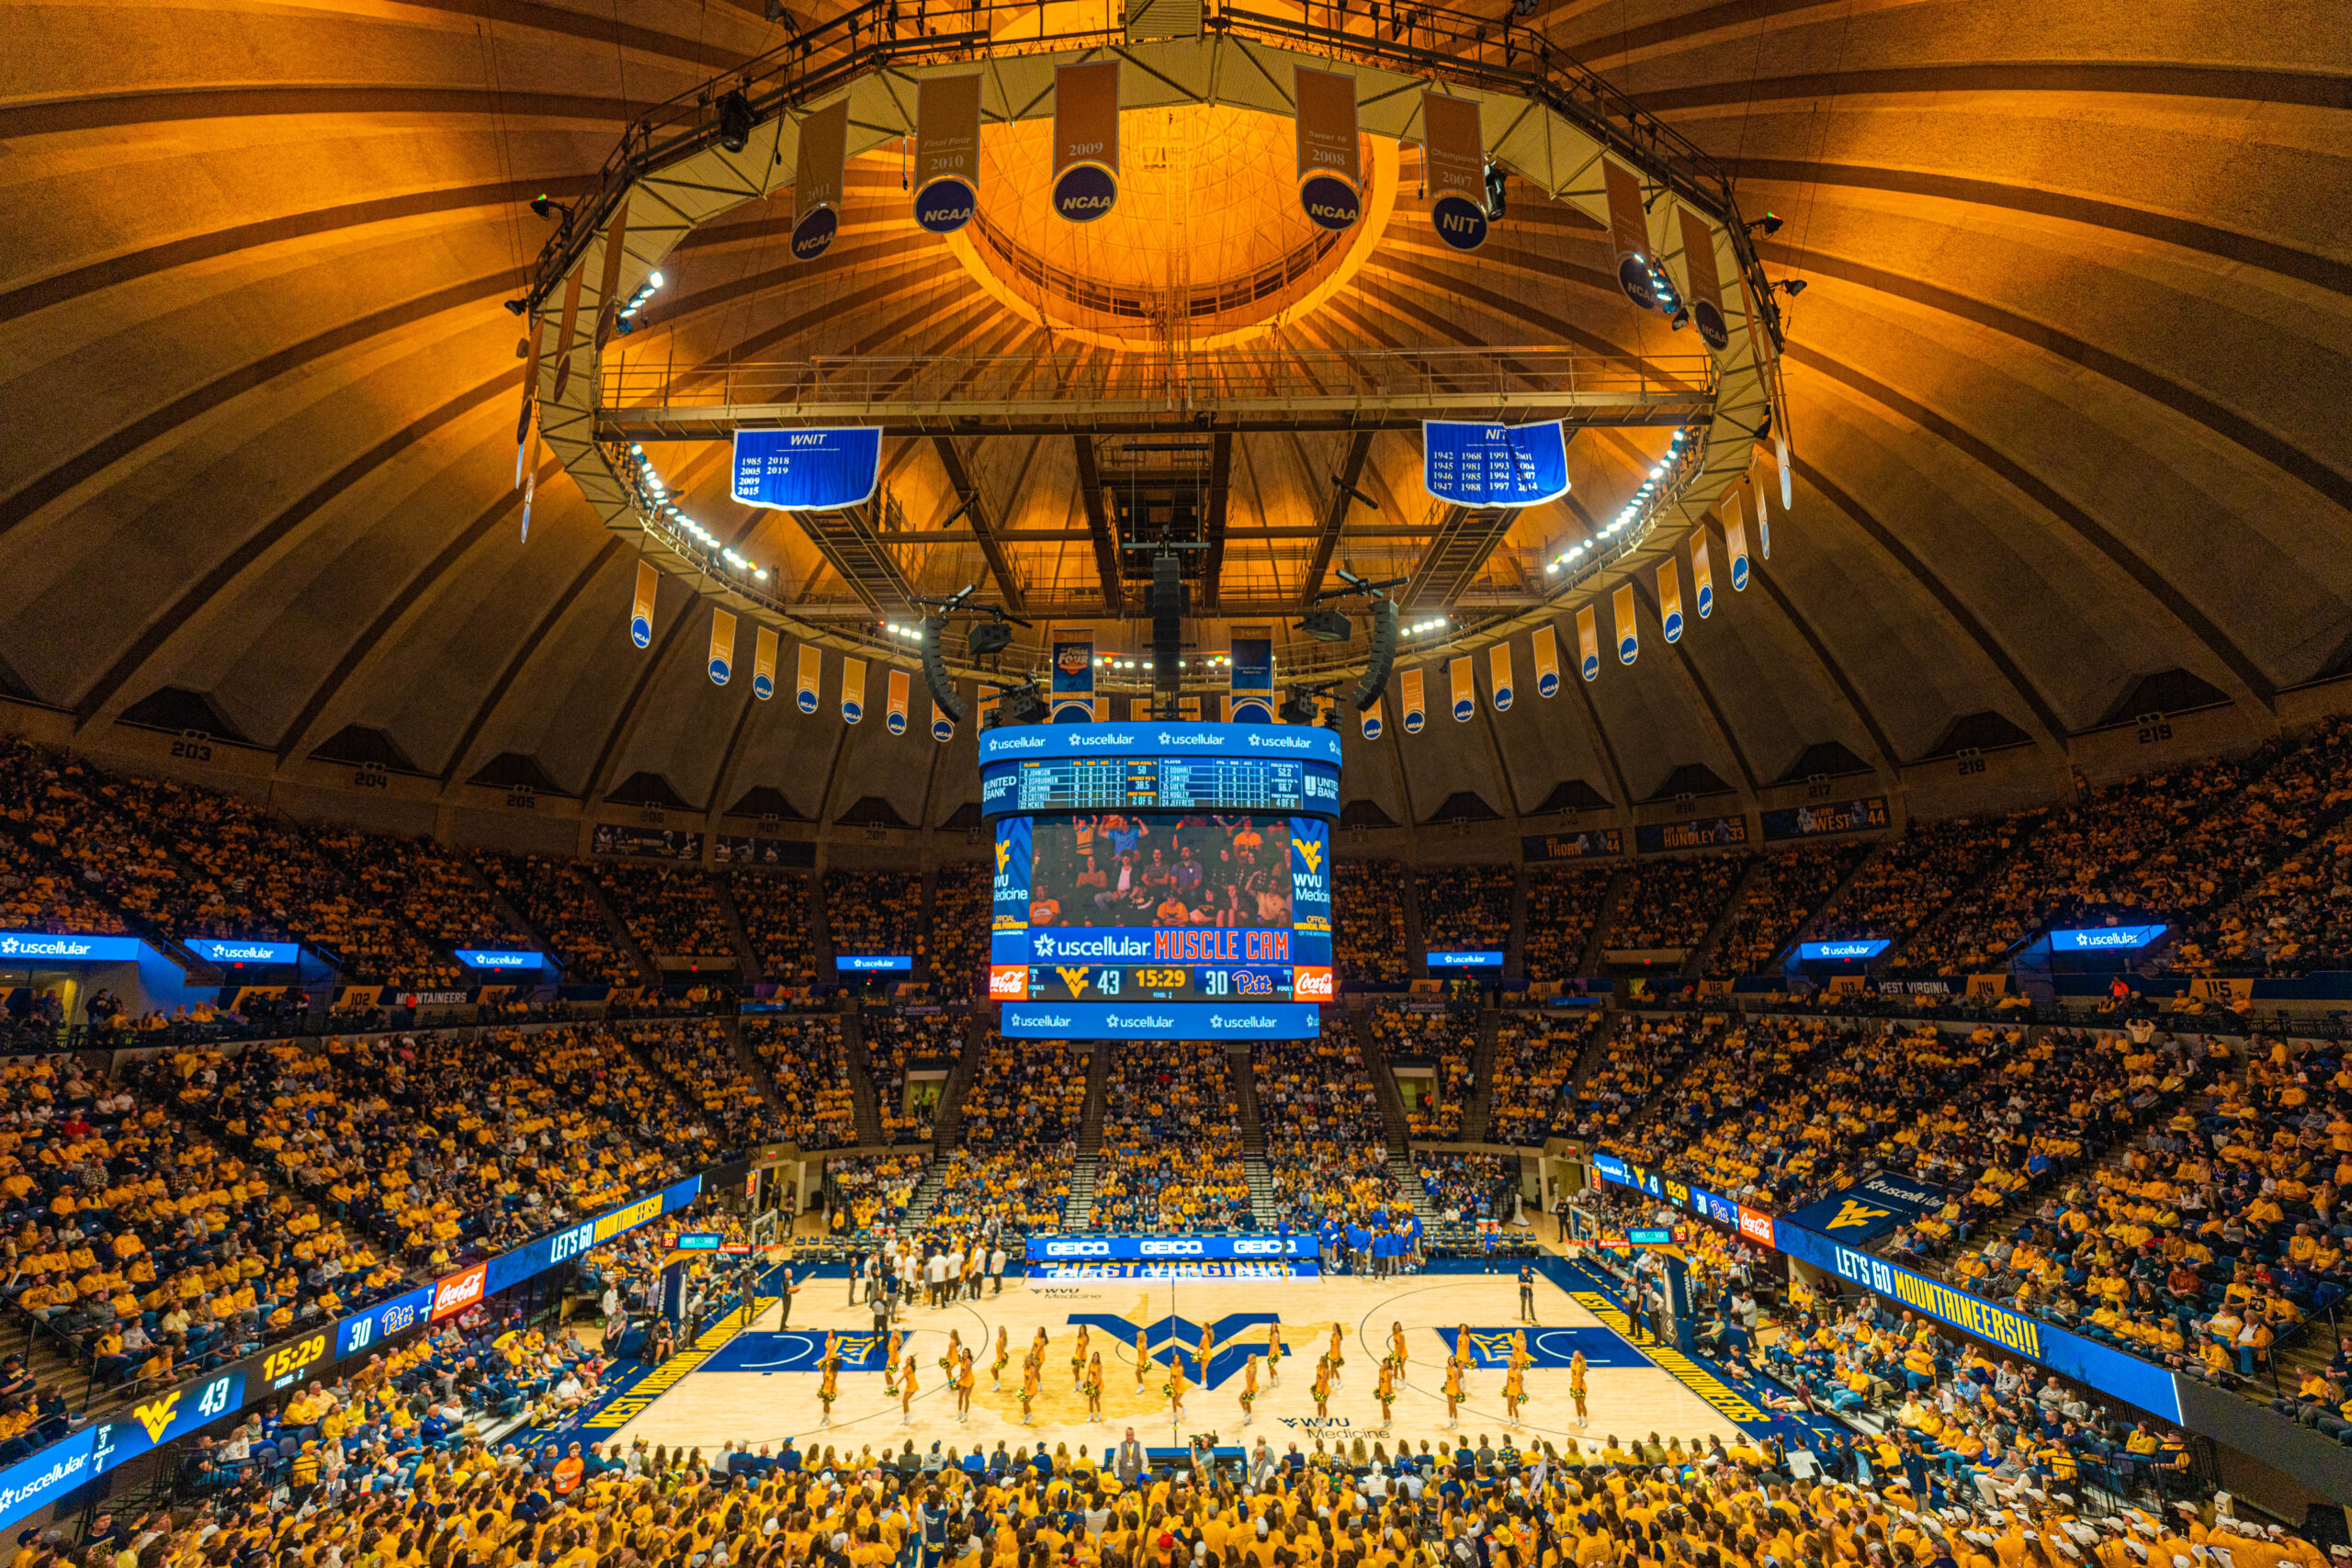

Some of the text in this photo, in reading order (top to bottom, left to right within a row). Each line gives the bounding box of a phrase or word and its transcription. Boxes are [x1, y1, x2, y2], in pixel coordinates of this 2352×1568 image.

[923, 136, 972, 148] Final Four
[1338, 135, 1347, 143] 16
[1069, 141, 1104, 156] 2009
[930, 154, 964, 171] 2010
[1312, 149, 1346, 165] 2008
[1430, 148, 1479, 164] Champions
[1442, 172, 1472, 187] 2007
[1062, 196, 1112, 210] NCAA
[923, 208, 972, 223] NCAA
[1311, 203, 1359, 220] NCAA
[1442, 213, 1479, 234] NIT
[797, 230, 834, 252] NCAA
[1702, 324, 1727, 344] NCAA
[790, 434, 827, 446] WNIT
[741, 457, 790, 466] 1985 2018
[1433, 451, 1509, 460] 1942 1968 1991
[740, 467, 789, 475] 2005 2019
[1433, 461, 1510, 470] 1945 1981 1993
[738, 478, 760, 486] 2009
[1433, 471, 1510, 480] 1946 1985 1994
[737, 486, 760, 495] 2015
[1433, 481, 1510, 491] 1947 1988 1997
[634, 631, 650, 644] NCAA
[1668, 625, 1683, 638] NCAA
[1623, 649, 1638, 661] NCAA
[711, 671, 729, 682] NCAA
[1585, 666, 1599, 677] NCAA
[756, 687, 772, 696] NCAA
[1542, 683, 1558, 694] NCAA
[800, 701, 817, 710] NCAA
[1498, 698, 1513, 707] NCAA
[844, 712, 862, 720] NCAA
[1456, 710, 1474, 718] NCAA
[890, 723, 906, 731] NCAA
[998, 737, 1046, 750] uscellular
[1082, 734, 1135, 746] uscellular
[1172, 734, 1225, 746] uscellular
[1261, 737, 1312, 749] uscellular
[171, 741, 211, 761] 203
[1137, 765, 1146, 775] 50
[1958, 760, 1986, 776] 218
[355, 771, 388, 789] 204
[987, 775, 1017, 789] UNITED
[1135, 781, 1150, 790] 38.5
[987, 787, 1006, 801] BANK
[1317, 787, 1337, 801] BANK
[506, 795, 536, 809] 205
[1815, 813, 1850, 831] WEST
[1868, 809, 1885, 825] 44
[1664, 829, 1715, 847] HUNDLEY
[1730, 828, 1745, 840] 33
[1606, 840, 1620, 852] 44
[1293, 874, 1322, 887] WVU
[2088, 931, 2138, 945] uscellular
[20, 942, 91, 955] uscellular
[1057, 931, 1288, 960] uscellular MUSCLE CAM
[1830, 945, 1869, 955] uscellular
[226, 947, 274, 959] uscellular
[486, 955, 524, 965] uscellular
[1453, 954, 1485, 964] uscellular
[862, 959, 895, 967] uscellular
[1096, 970, 1120, 995] 43
[1136, 970, 1186, 987] 15:29
[1205, 971, 1227, 995] 30
[1232, 970, 1272, 995] Pitt
[1880, 981, 1950, 995] WEST VIRGINIA
[2205, 981, 2232, 997] 115
[351, 992, 370, 1006] 102
[1021, 1015, 1071, 1027] uscellular
[1120, 1015, 1174, 1028] uscellular
[1224, 1015, 1277, 1028] uscellular
[1650, 1175, 1658, 1193] 43
[1665, 1179, 1688, 1201] 15:29
[1696, 1193, 1707, 1214] 30
[1710, 1200, 1729, 1224] Pitt
[551, 1193, 663, 1263] LET'S GO MOUNTAINEERS!!!
[1741, 1213, 1770, 1239] Coca-Cola
[663, 1238, 673, 1247] 30
[1046, 1239, 1296, 1256] GEICO GEICO GEICO
[1057, 1262, 1141, 1278] WEST
[436, 1271, 483, 1312] Coca-Cola
[1835, 1246, 2041, 1359] LET'S GO MOUNTAINEERS!!!
[382, 1305, 413, 1337] Pitt
[348, 1317, 372, 1352] 30
[263, 1335, 325, 1382] 15:29
[198, 1377, 230, 1416] 43
[582, 1351, 712, 1428] WEST VIRGINIA
[98, 1424, 112, 1435] TOL
[1307, 1428, 1390, 1439] Medicine
[98, 1433, 107, 1450] 3
[94, 1444, 115, 1461] FOULS
[96, 1457, 103, 1472] 4
[15, 1452, 88, 1503] uscellular
